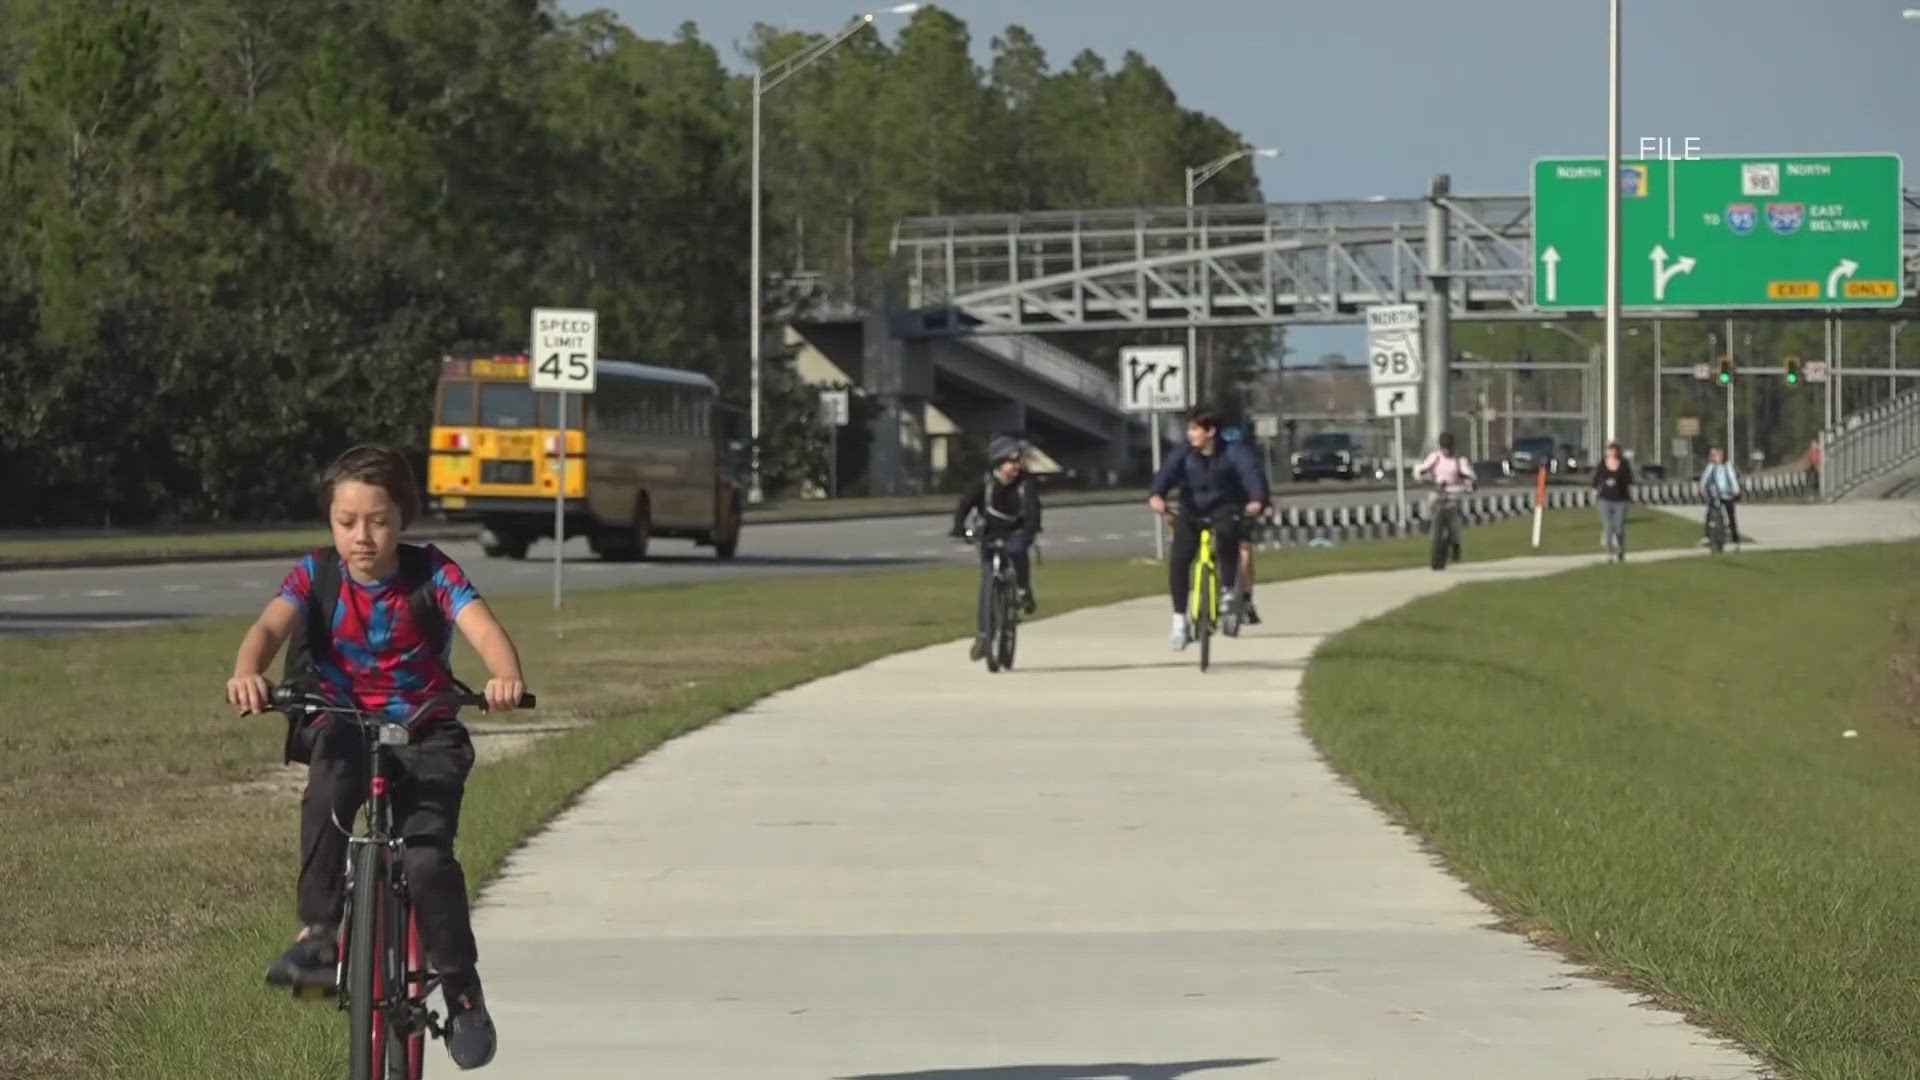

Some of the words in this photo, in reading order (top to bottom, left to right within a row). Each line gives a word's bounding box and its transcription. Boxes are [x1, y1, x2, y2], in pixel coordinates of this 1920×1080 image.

[1556, 166, 1602, 178] NORTH
[1785, 163, 1831, 176] NORTH
[1810, 205, 1842, 217] EAST
[1810, 219, 1869, 232] BELTWAY
[1778, 284, 1809, 296] EXIT
[1847, 283, 1889, 296] ONLY
[539, 319, 591, 333] SPEED
[545, 335, 583, 348] LIMIT
[539, 352, 589, 380] 45
